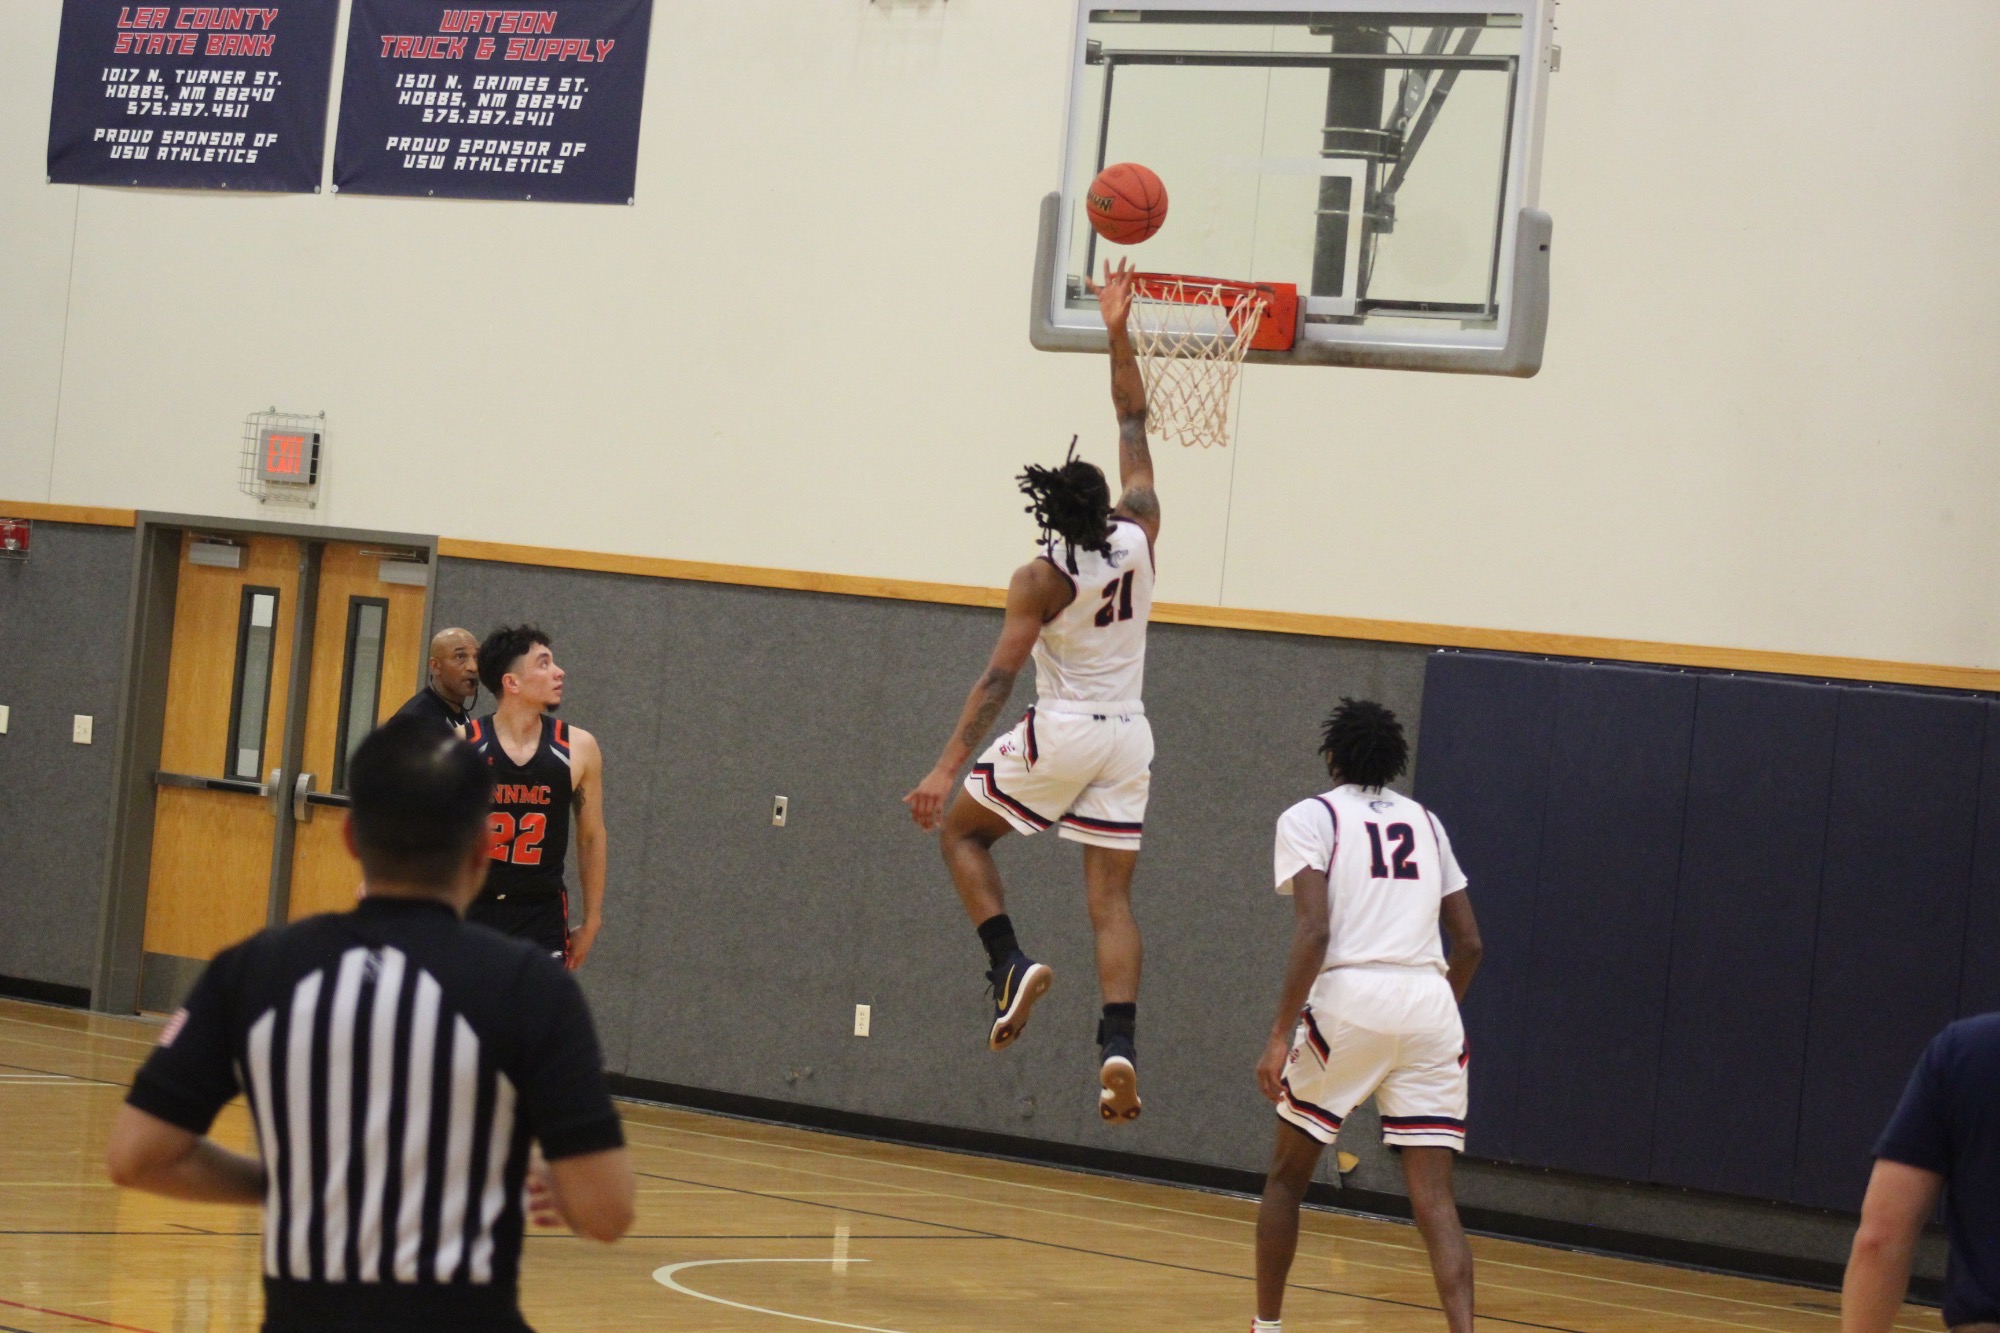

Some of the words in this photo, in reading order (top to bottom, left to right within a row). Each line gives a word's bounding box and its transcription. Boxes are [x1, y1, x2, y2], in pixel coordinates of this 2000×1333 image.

[117, 7, 170, 28] LEA
[175, 8, 278, 30] COUNTY
[439, 10, 557, 34] WATSON
[114, 32, 199, 55] STATE
[205, 34, 275, 56] BANK
[381, 36, 468, 59] TRUCK
[475, 37, 496, 60] &
[504, 38, 615, 62] SUPPLY
[102, 68, 139, 82] 1017
[147, 69, 163, 83] N.
[176, 70, 246, 85] TURNER
[254, 71, 281, 85] ST.
[396, 74, 436, 88] 1501
[445, 75, 462, 90] N.
[473, 76, 550, 92] GRIMES
[558, 78, 588, 92] ST.
[106, 85, 168, 101] HOBBS,
[179, 86, 206, 100] NM
[214, 87, 275, 102] 88240
[399, 91, 466, 108] HOBBS,
[477, 93, 507, 108] NM
[516, 94, 583, 109] 88240
[127, 101, 249, 118] 575.397.4511
[422, 108, 554, 126] 575.397.2411
[94, 129, 153, 143] PROUD
[161, 131, 245, 146] SPONSOR
[253, 133, 278, 147] OF
[386, 137, 450, 152] PROUD
[459, 139, 550, 156] SPONSOR
[559, 142, 586, 156] OF
[110, 146, 149, 160] USW
[157, 147, 258, 163] ATHLETICS
[403, 154, 445, 169] USW
[454, 156, 564, 173] ATHLETICS
[267, 435, 304, 474] EXIT
[1094, 569, 1135, 627] 21
[486, 811, 547, 865] 22
[1364, 821, 1420, 880] 12
